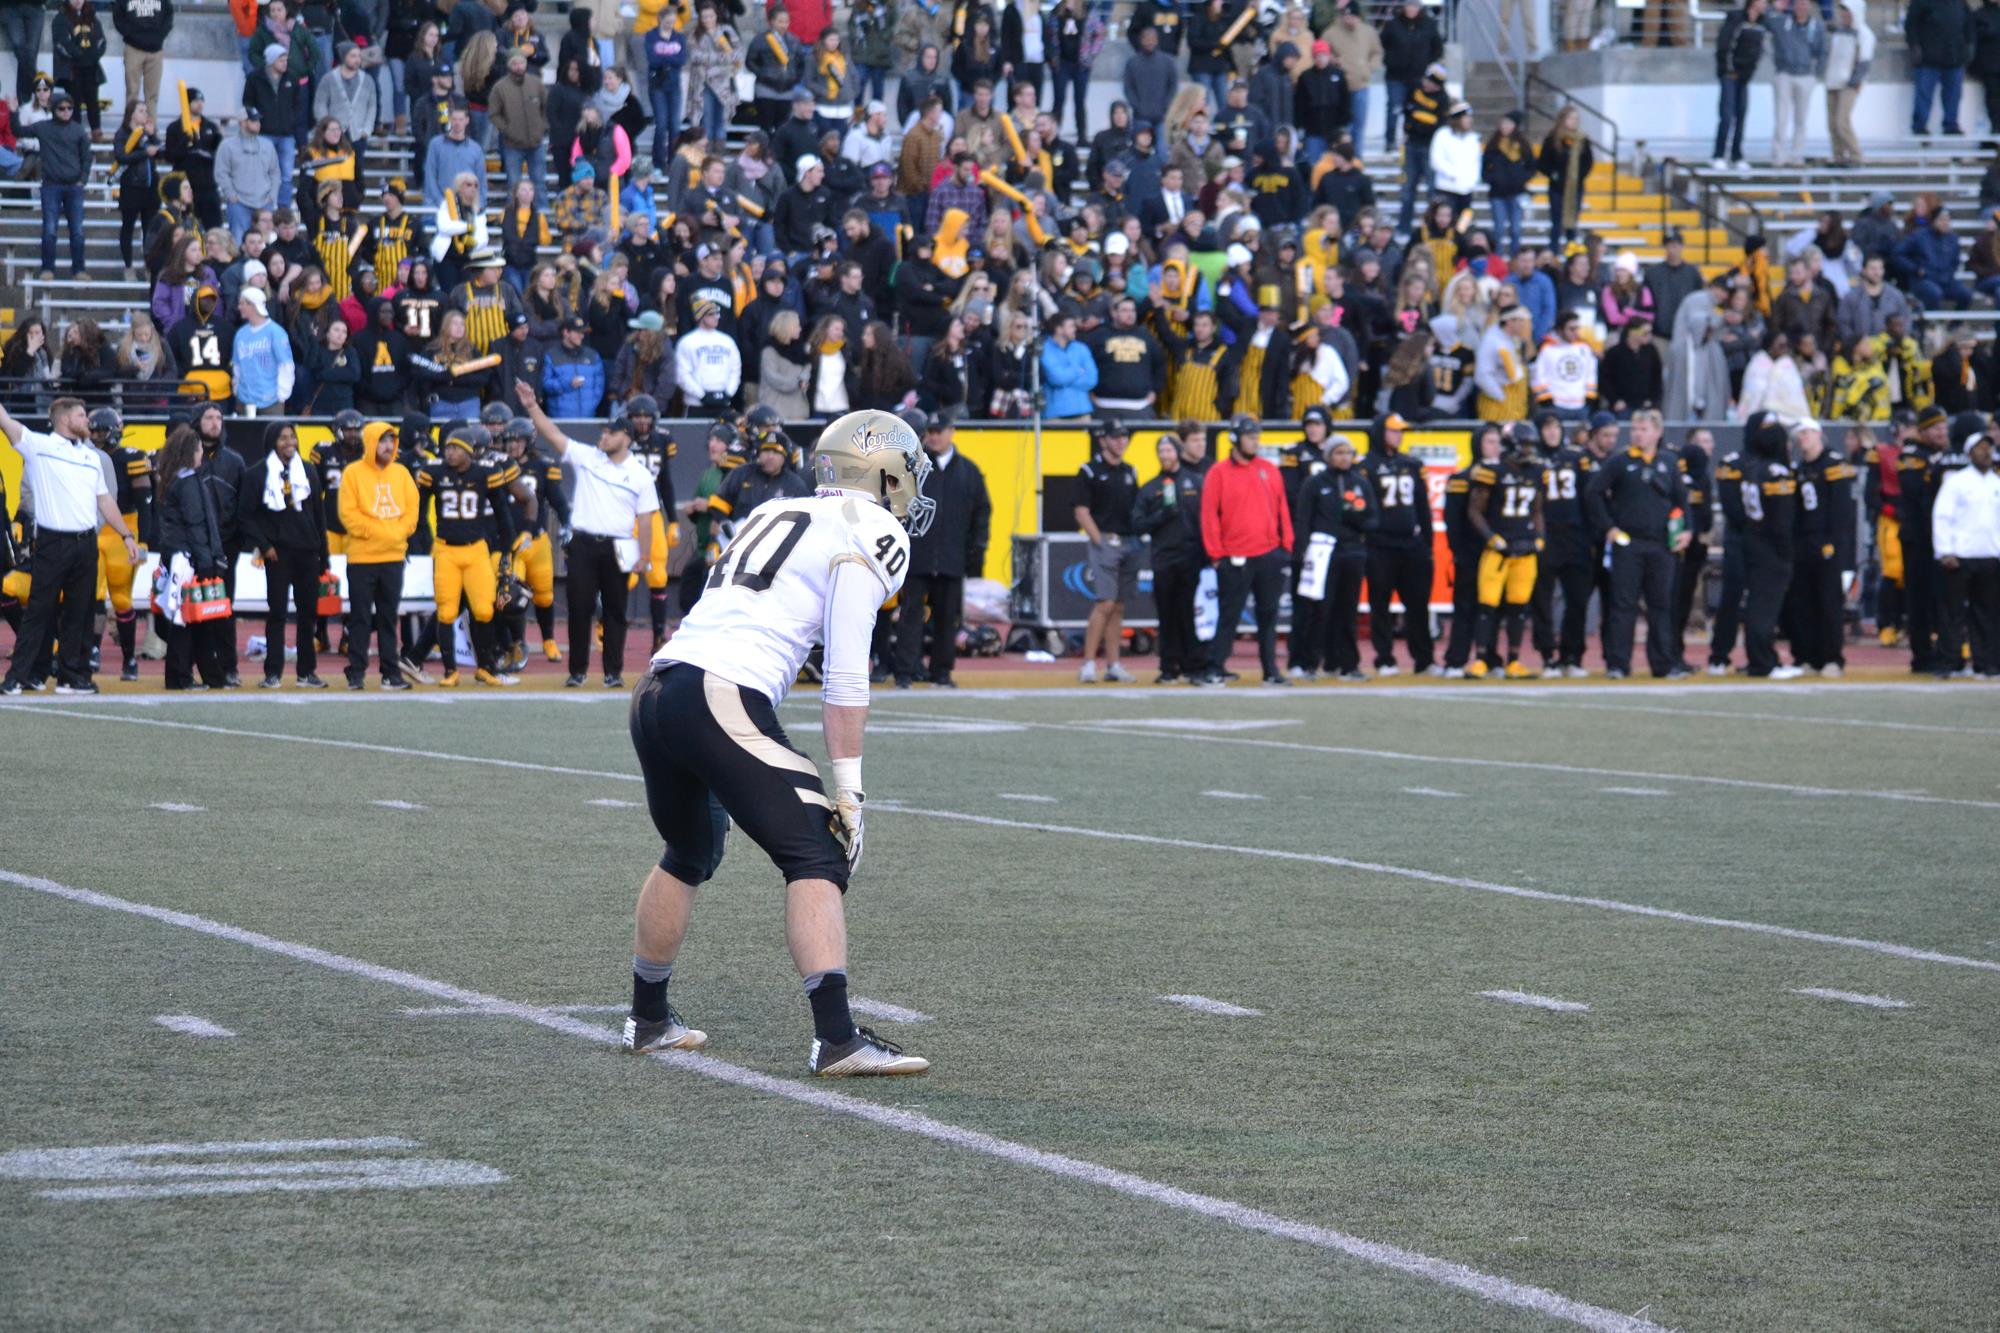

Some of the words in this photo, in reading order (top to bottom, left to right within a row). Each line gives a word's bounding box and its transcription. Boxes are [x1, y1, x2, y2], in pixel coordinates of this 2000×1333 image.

[189, 336, 221, 367] 14
[851, 422, 918, 457] Vanda
[1380, 475, 1415, 507] 79
[1547, 469, 1577, 500] 13
[441, 490, 478, 520] 20
[1503, 486, 1536, 517] 17
[875, 533, 907, 576] 40
[622, 1016, 638, 1050] NIKE
